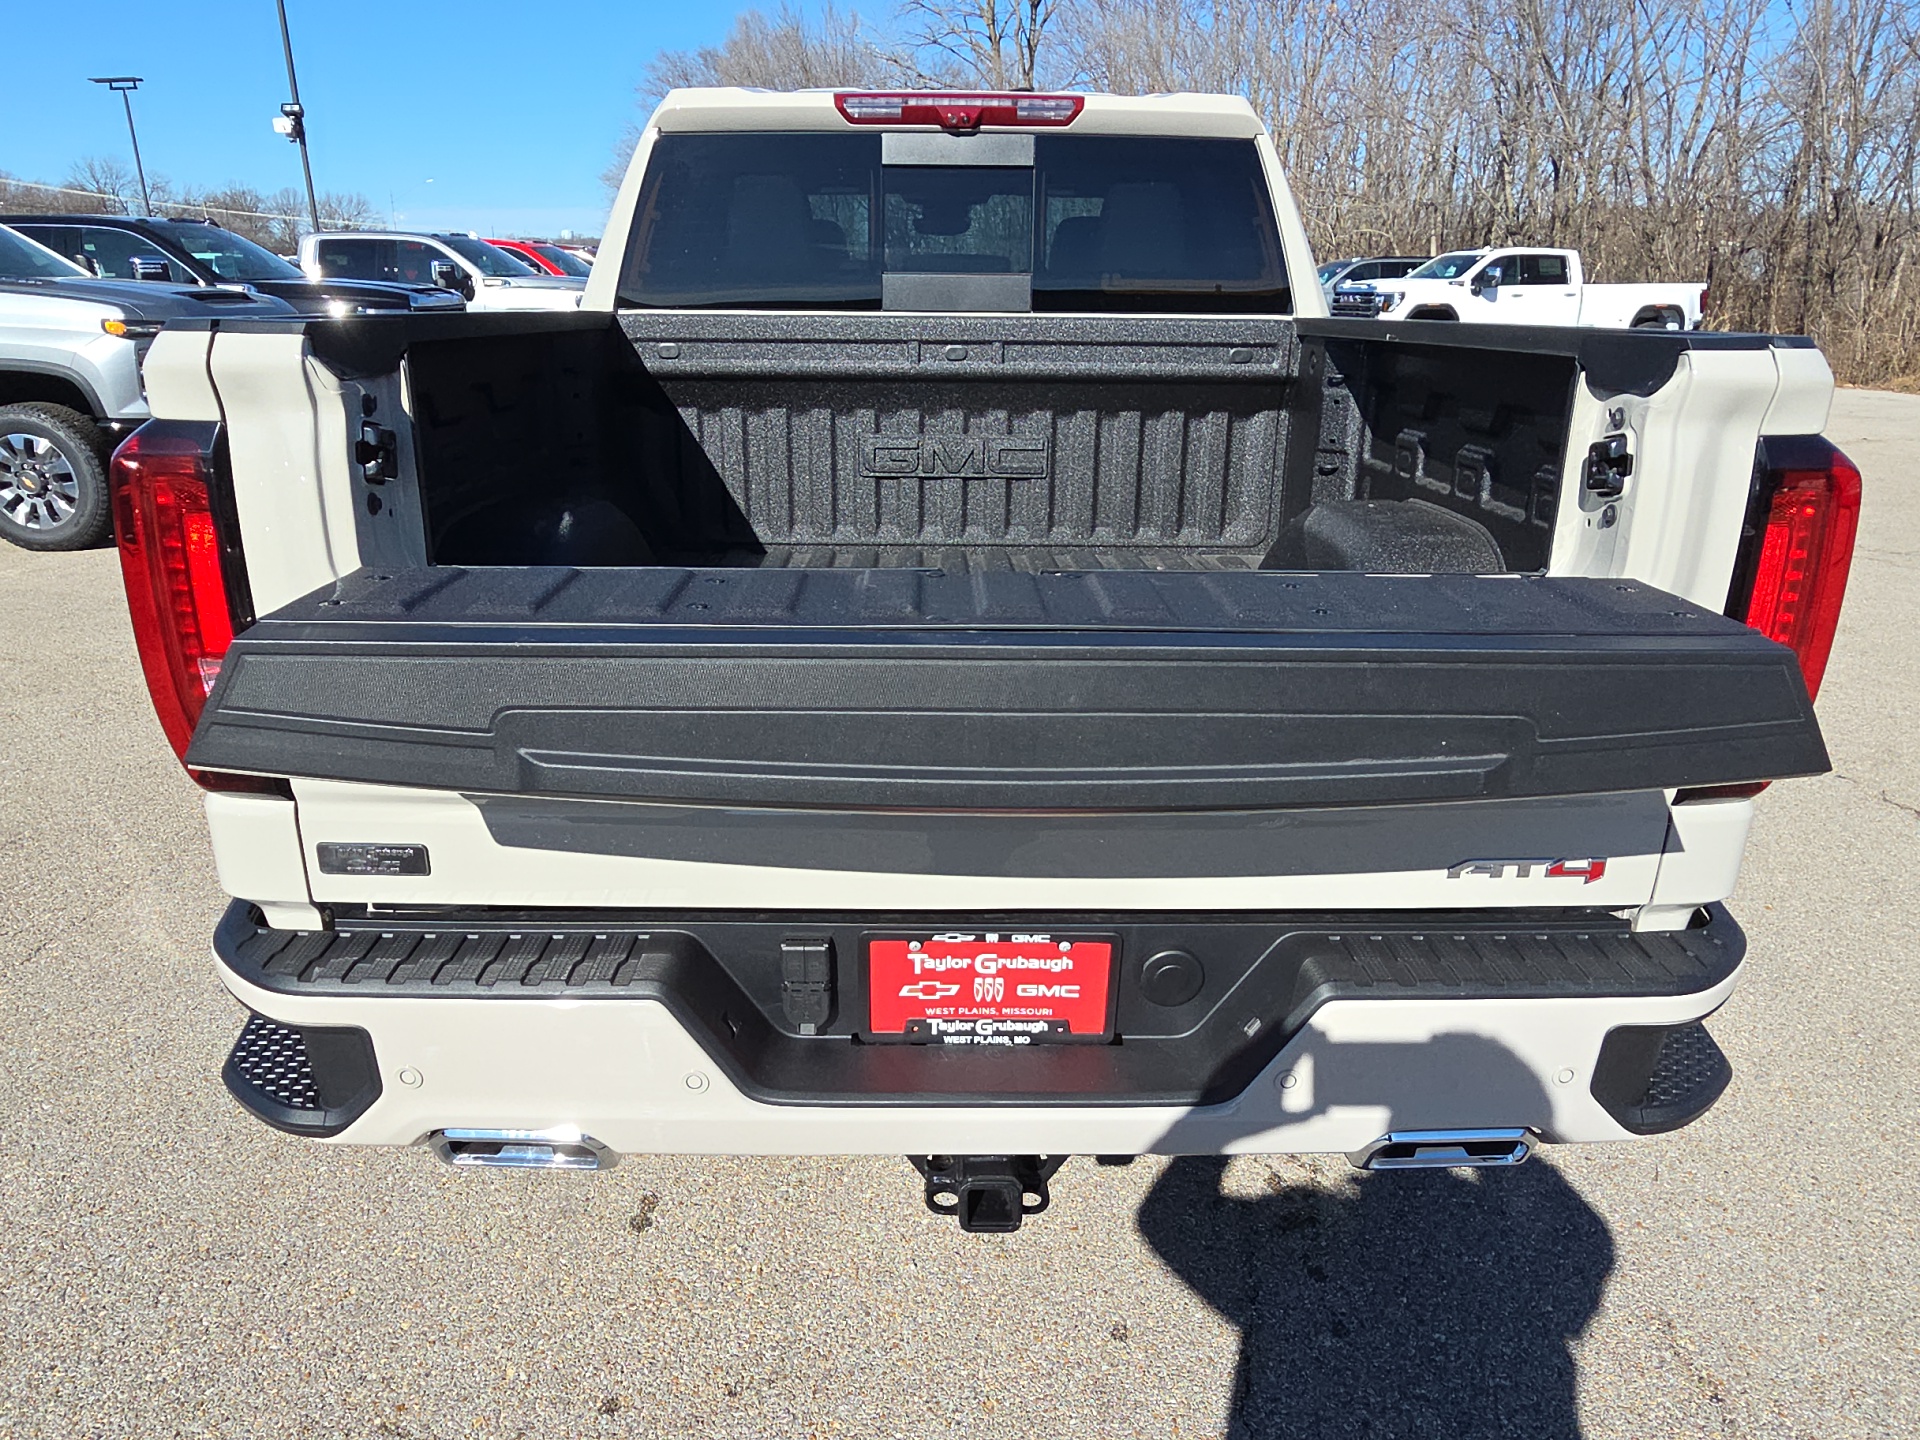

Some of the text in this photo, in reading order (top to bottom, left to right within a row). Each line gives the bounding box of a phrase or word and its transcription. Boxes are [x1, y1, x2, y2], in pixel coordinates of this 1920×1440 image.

[859, 434, 1048, 478] GMC
[1447, 857, 1608, 884] AT4
[1011, 934, 1051, 943] GMC
[907, 953, 1073, 974] Taylor Grubaugh
[1016, 984, 1081, 998] GMC
[925, 1007, 1053, 1016] WEST PLAINS, MISSOURI
[926, 1019, 1048, 1035] Taylor Grubaugh
[943, 1035, 1031, 1046] WEST PLAINS, MO
